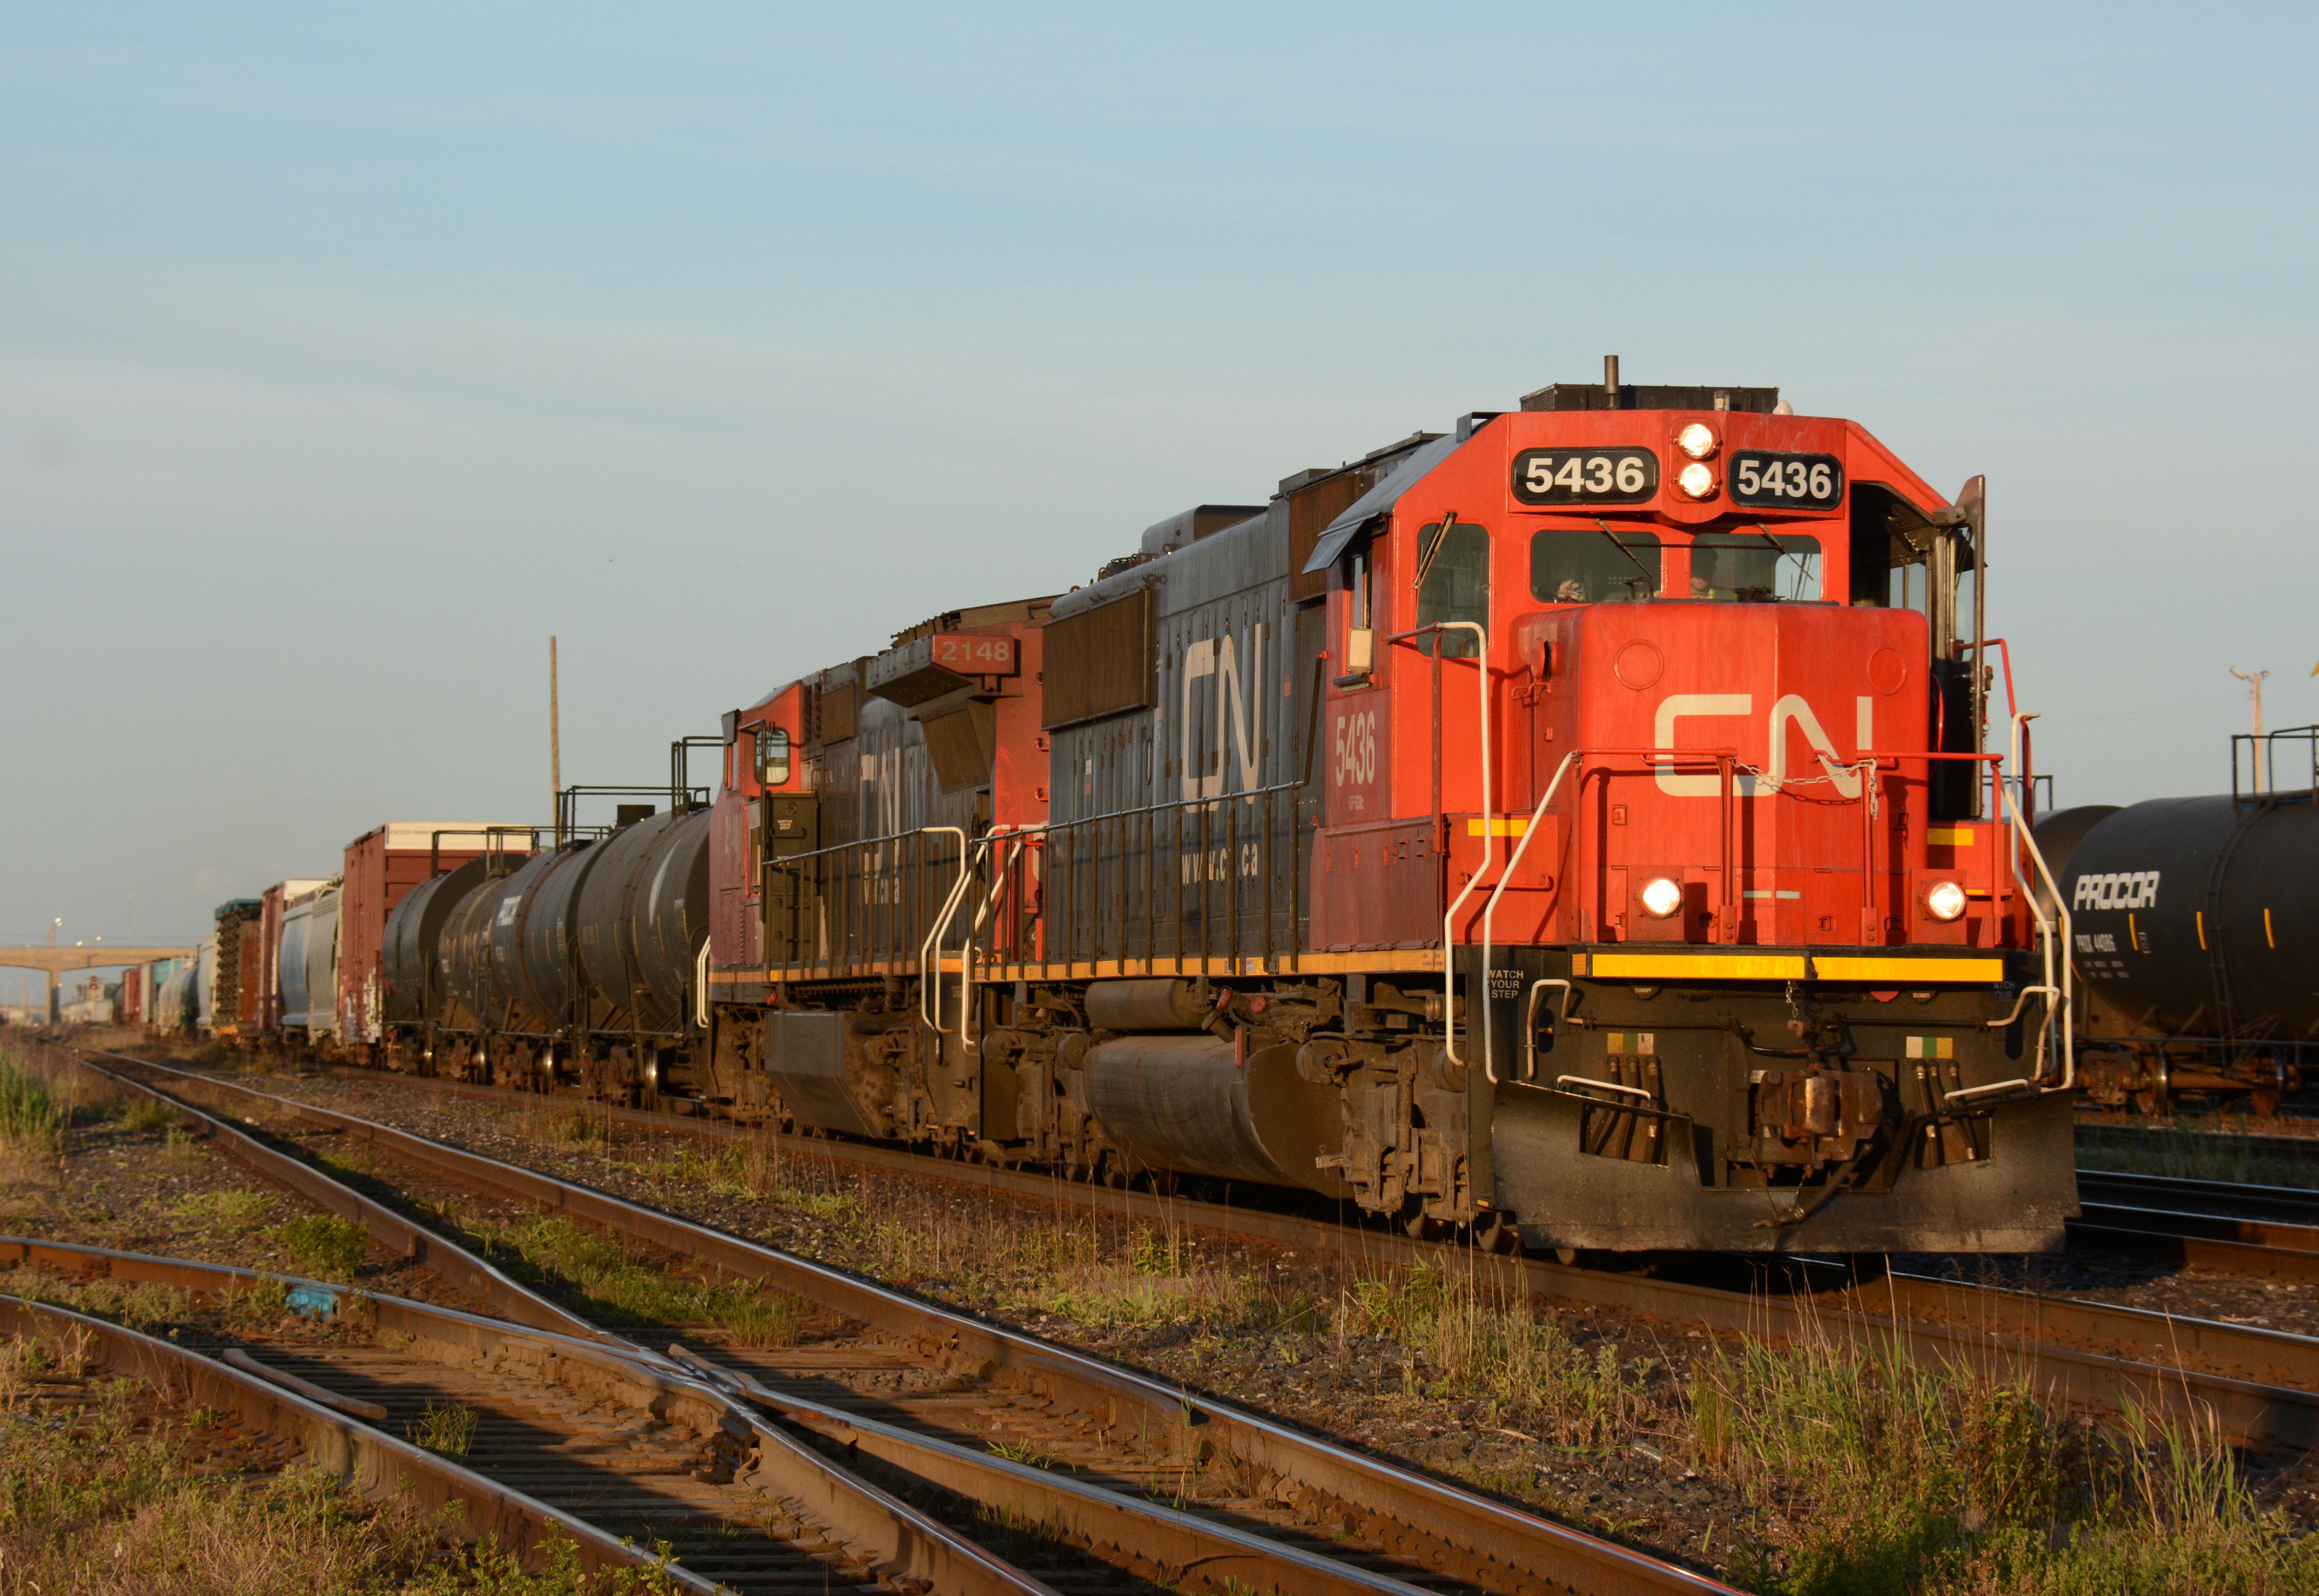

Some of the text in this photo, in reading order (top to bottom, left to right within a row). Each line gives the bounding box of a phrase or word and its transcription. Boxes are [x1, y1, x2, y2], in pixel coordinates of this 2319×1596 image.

[1526, 457, 1645, 494] 5436
[1738, 460, 1832, 499] 5436
[941, 641, 1009, 661] 2148
[1182, 623, 1261, 814] CN
[1335, 711, 1375, 786] 5436
[1655, 694, 1873, 798] CN
[2073, 871, 2160, 911] PROCOR
[1489, 970, 1523, 979] WATCH
[1491, 980, 1519, 989] YOUR
[1492, 990, 1517, 998] STEP
